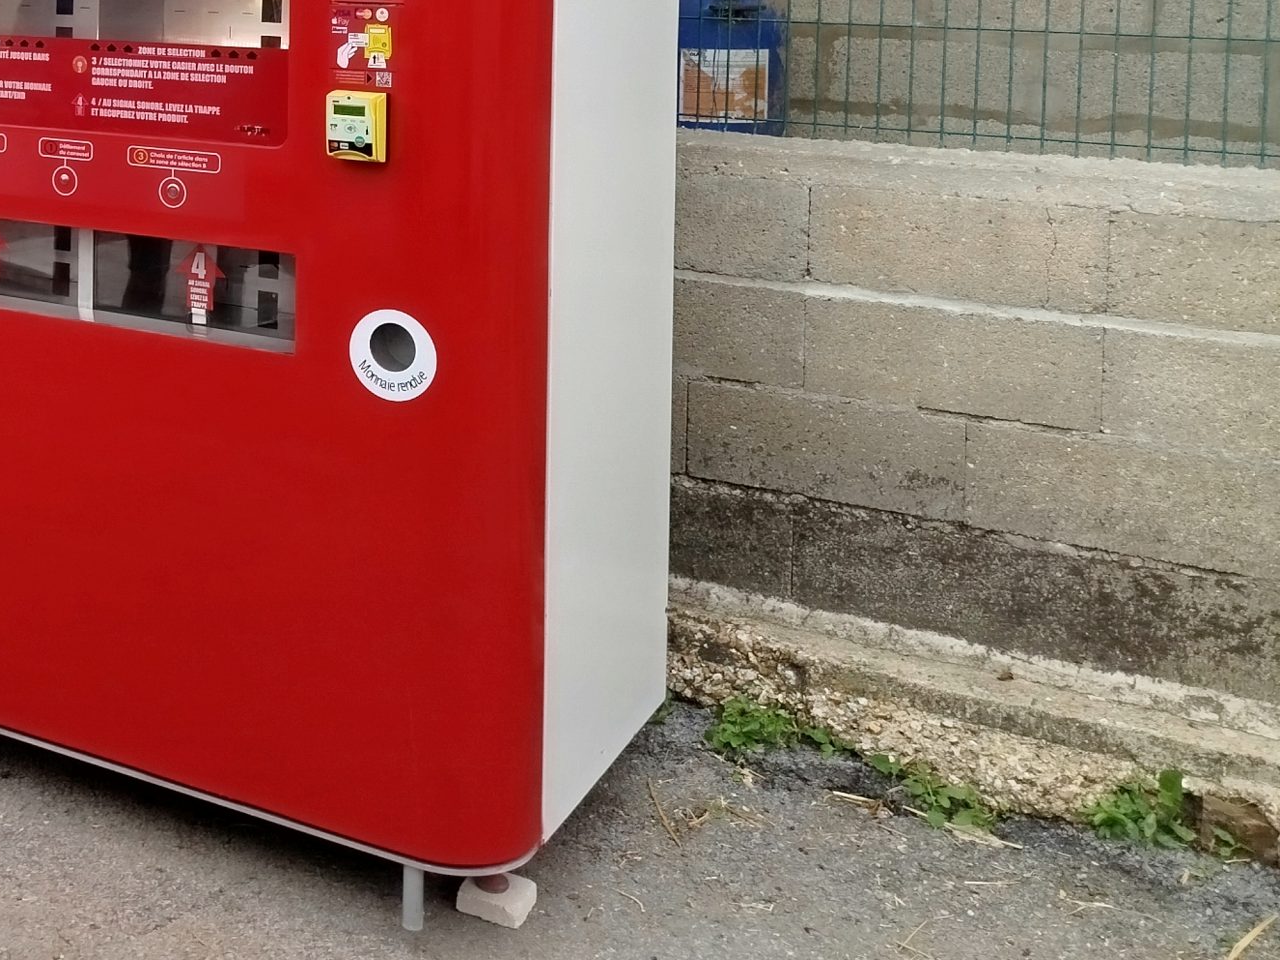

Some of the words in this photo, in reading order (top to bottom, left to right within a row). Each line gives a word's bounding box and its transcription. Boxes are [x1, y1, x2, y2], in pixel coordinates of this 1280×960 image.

[138, 46, 156, 55] ZONE
[156, 47, 166, 55] DE
[167, 48, 206, 57] SELECTION
[91, 56, 97, 65] 3
[103, 57, 149, 68] SELECTIONNEZ
[149, 60, 171, 69] VOTRE
[171, 61, 197, 71] CASIER
[197, 63, 215, 72] AVEC
[216, 64, 223, 72] LE
[224, 64, 254, 74] BOUTON
[91, 67, 147, 78] CORRESPONDANT
[153, 71, 162, 79] LA
[163, 71, 179, 80] ZONE
[180, 72, 189, 81] DE
[190, 73, 227, 83] SELECTION
[91, 77, 117, 86] GAUCHE
[118, 79, 128, 87] OU
[91, 97, 96, 106] 4
[102, 98, 111, 107] AU
[112, 99, 136, 109] SIGNAL
[165, 103, 184, 112] LEVEZ
[185, 104, 194, 113] LA
[194, 105, 221, 115] TRAPPE
[91, 108, 99, 116] ET
[100, 108, 135, 119] RECUPEREZ
[136, 111, 157, 120] VOTRE
[191, 252, 206, 279] 4
[358, 359, 395, 392] Monnaie
[397, 371, 428, 392] rendue
